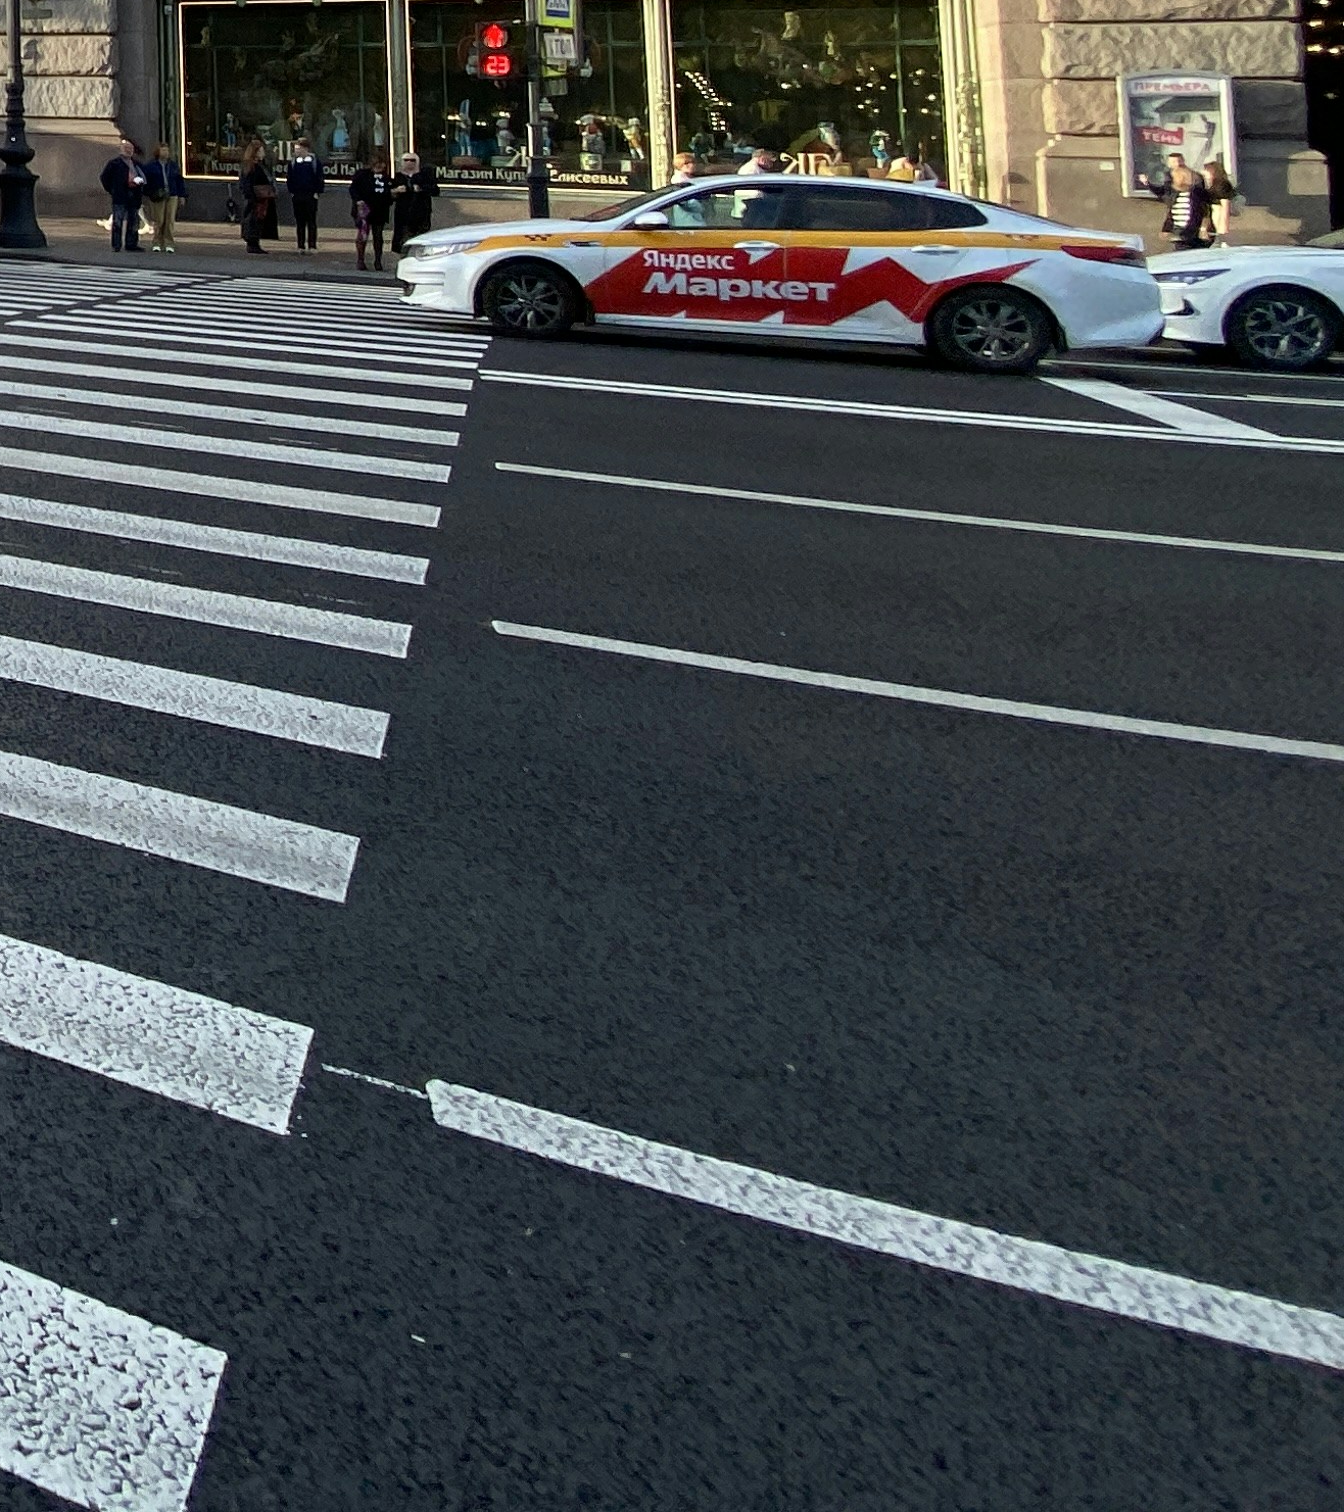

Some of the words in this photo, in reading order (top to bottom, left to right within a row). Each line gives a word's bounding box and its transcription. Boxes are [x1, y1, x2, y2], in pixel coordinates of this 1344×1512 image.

[486, 54, 511, 76] 23
[212, 160, 241, 174] Kupe
[436, 166, 493, 180] Магазин
[495, 168, 527, 183] Куп
[549, 169, 629, 186] Елисеевых
[642, 249, 735, 271] Яндекс
[642, 271, 836, 302] Маркет
